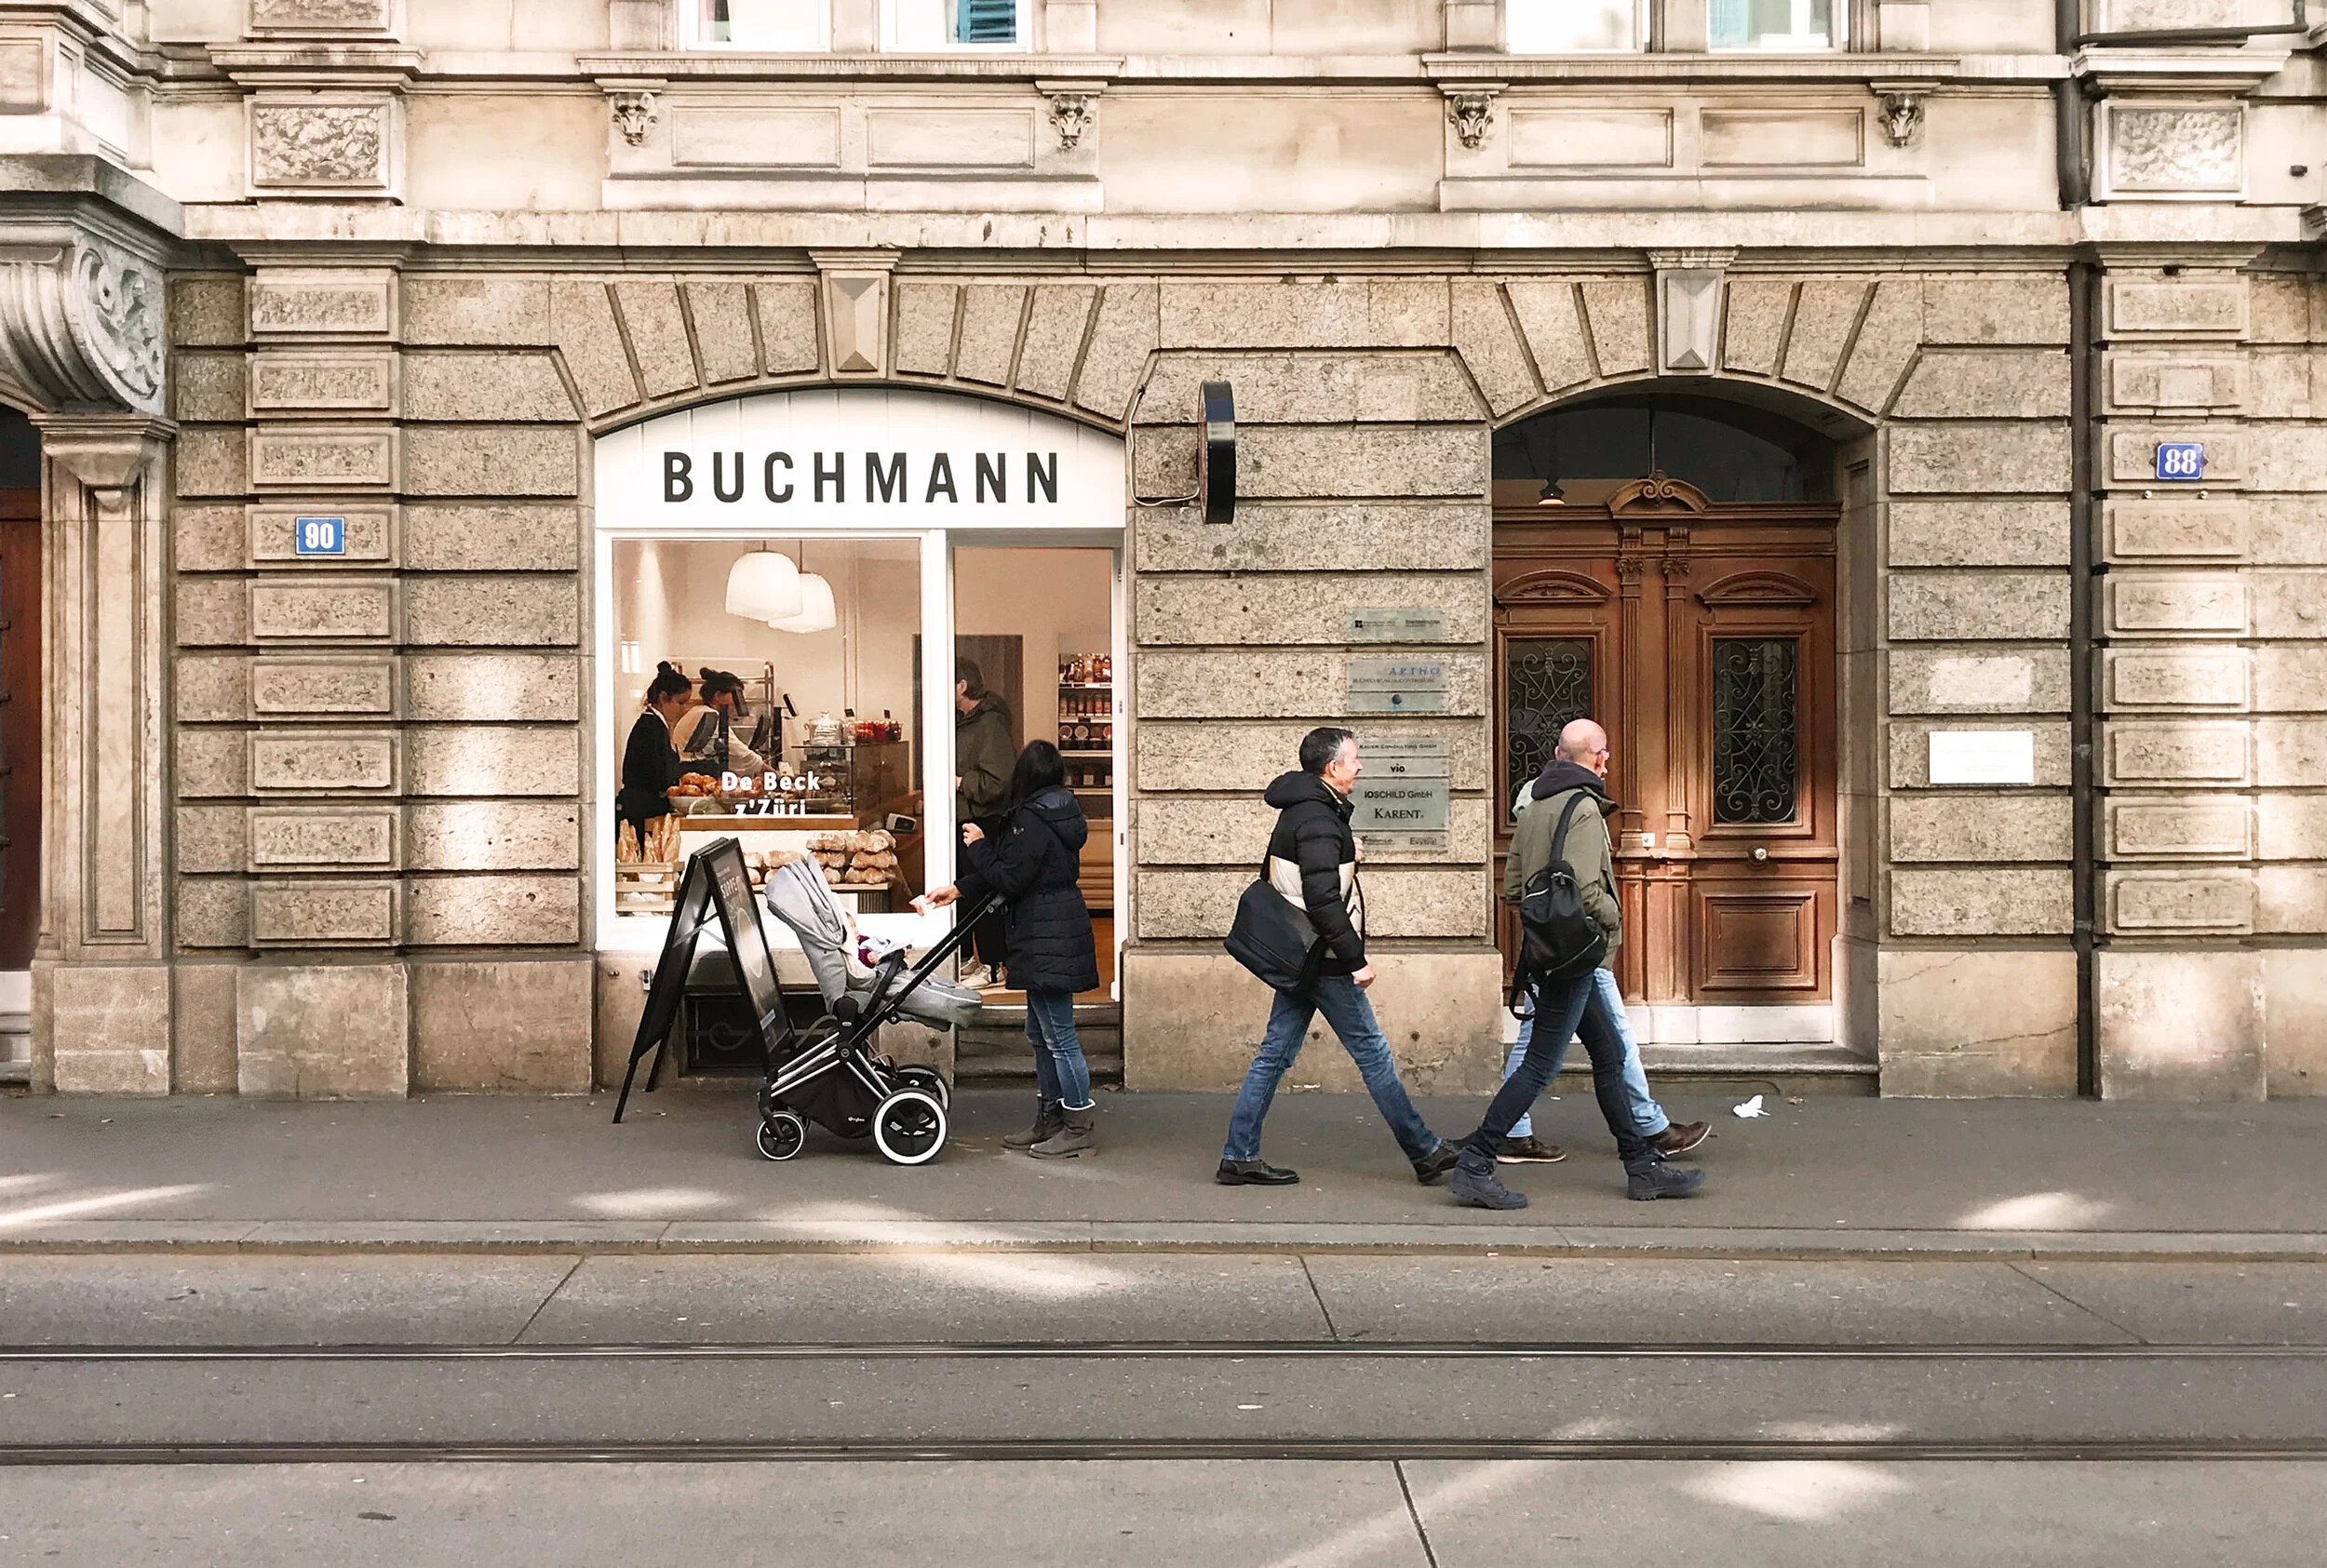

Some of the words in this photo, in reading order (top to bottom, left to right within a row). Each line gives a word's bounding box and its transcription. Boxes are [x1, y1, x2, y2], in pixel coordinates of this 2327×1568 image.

[2164, 449, 2197, 474] 88
[663, 451, 1057, 503] BUCHMANN
[305, 522, 334, 549] 90
[1389, 667, 1441, 676] ARTHO
[1391, 763, 1406, 772] vio
[721, 771, 753, 791] De
[763, 771, 821, 791] Beck
[1407, 790, 1433, 798] GmbH
[734, 798, 806, 816] z'Züri
